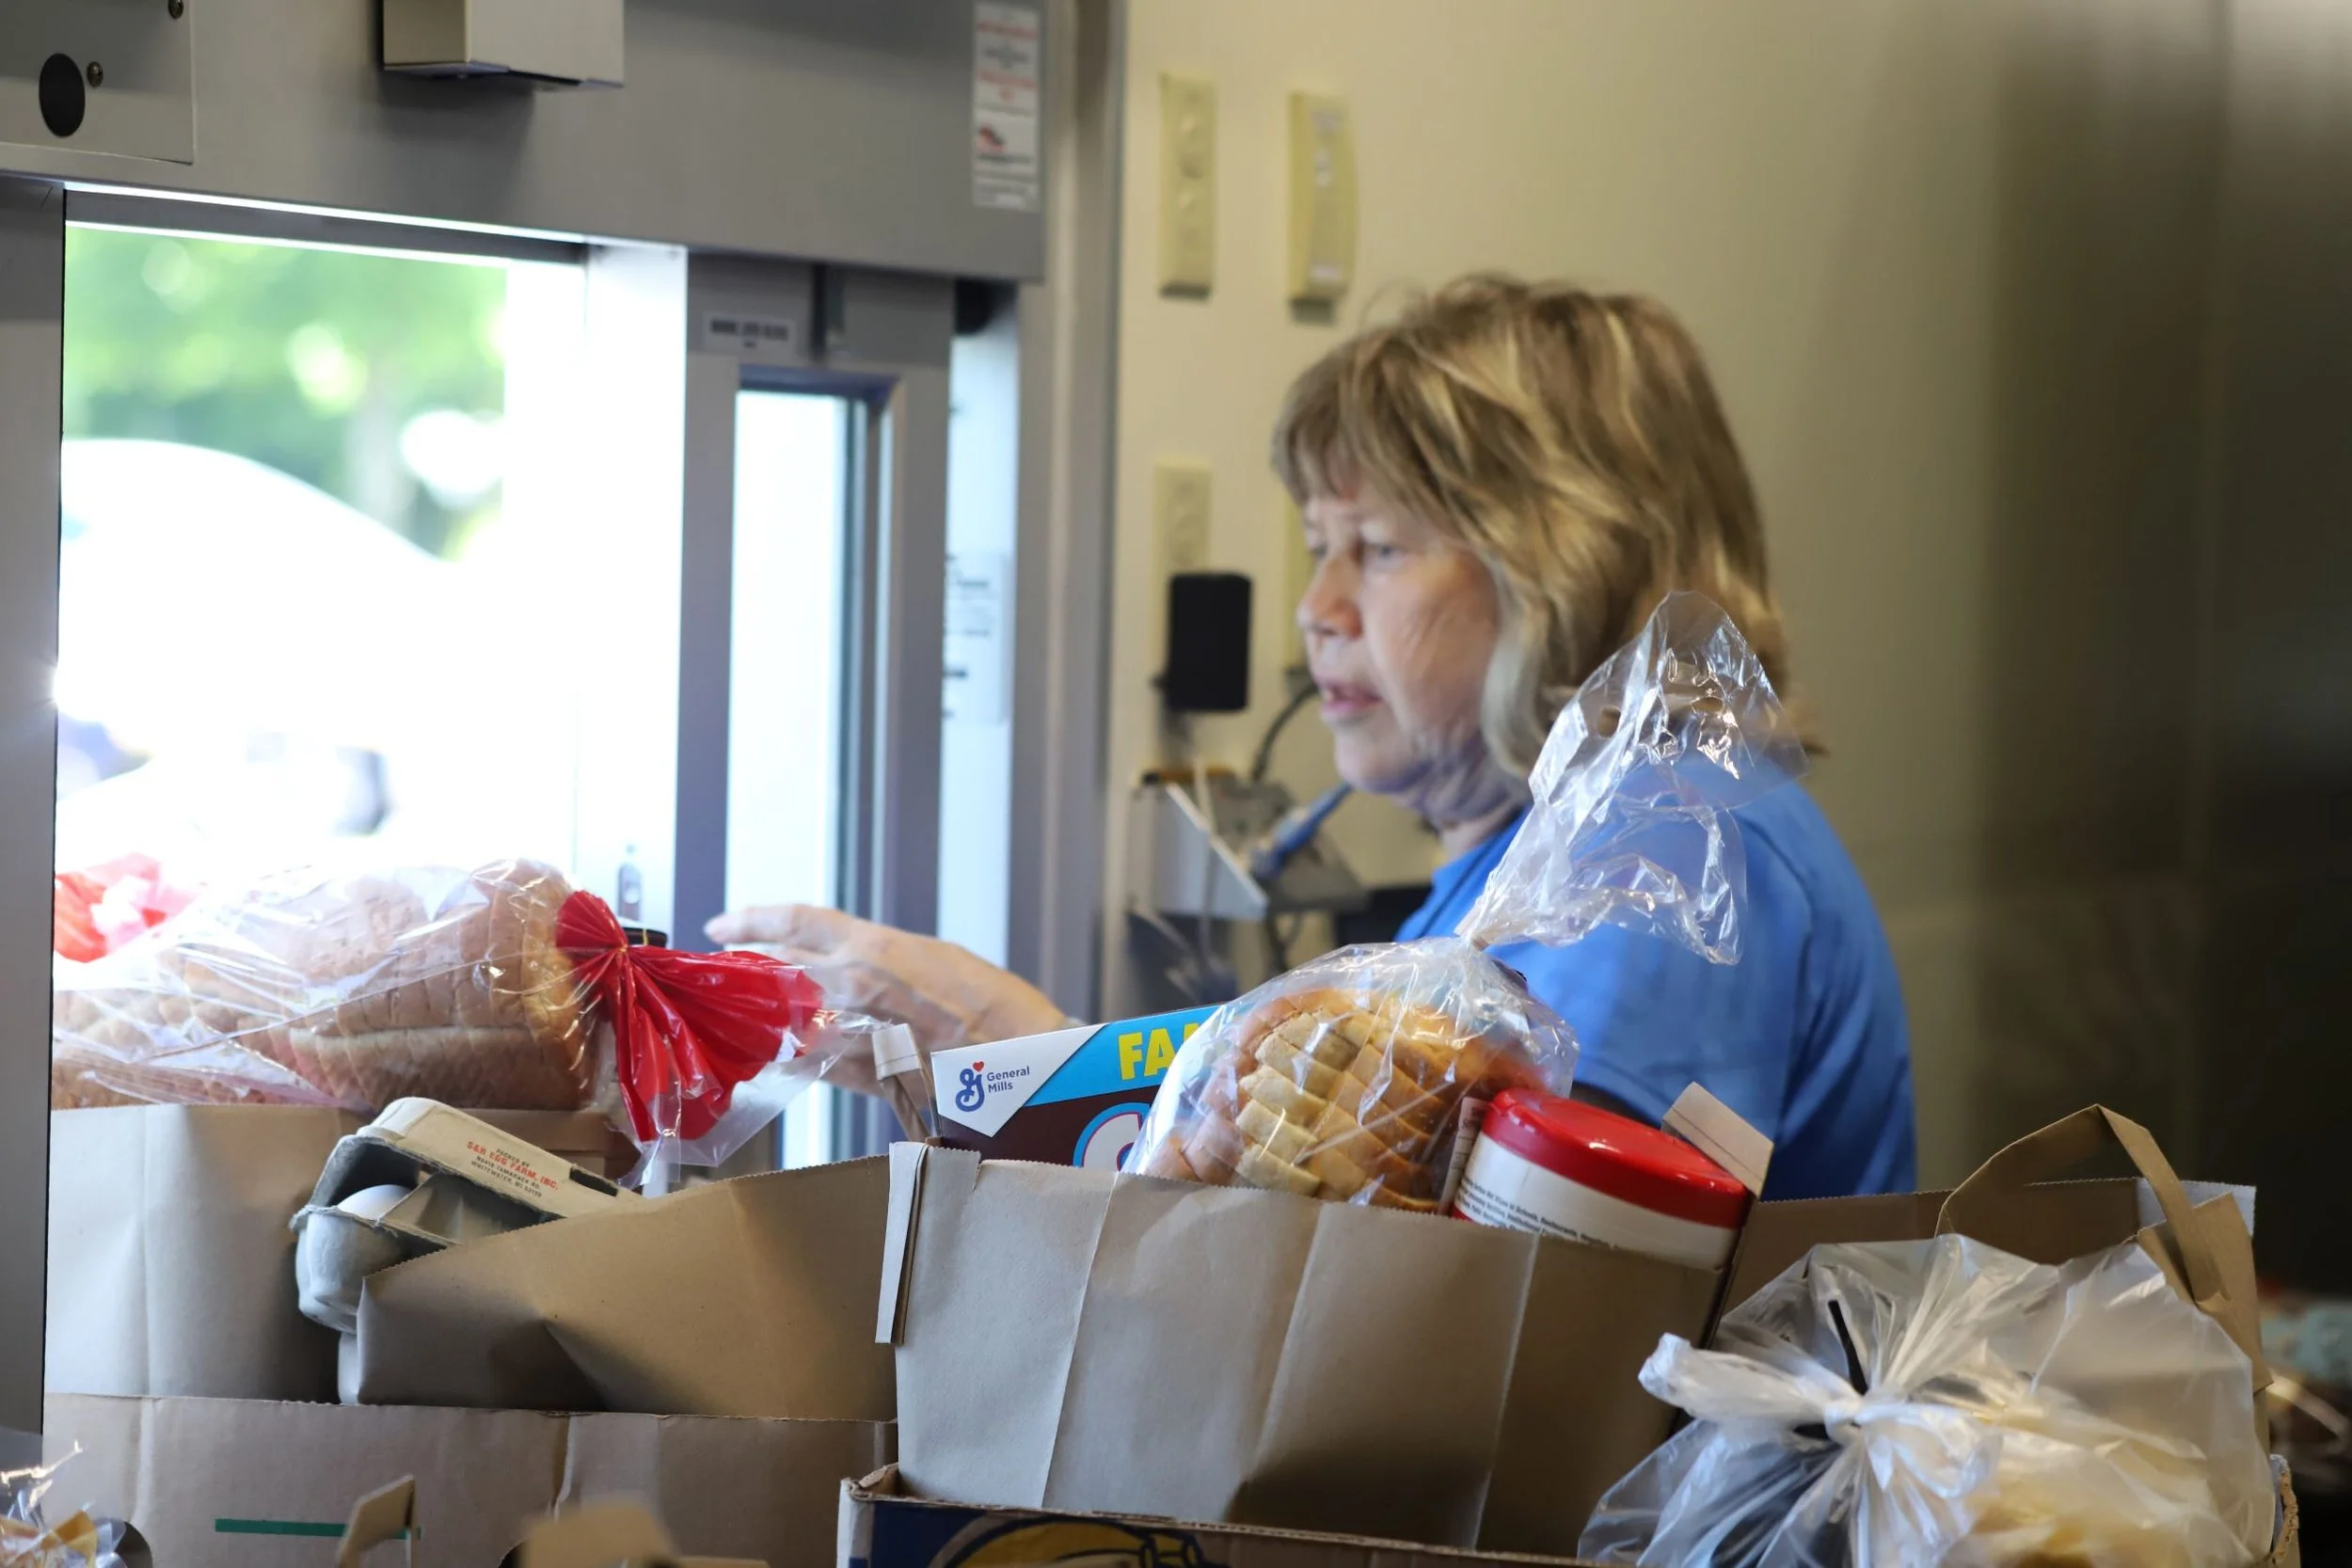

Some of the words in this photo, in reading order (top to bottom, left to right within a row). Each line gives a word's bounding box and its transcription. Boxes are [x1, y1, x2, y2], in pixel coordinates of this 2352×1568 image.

[1118, 1023, 1200, 1081] FA
[986, 1065, 1030, 1082] General
[988, 1081, 1013, 1094] Mills
[496, 1148, 520, 1164] PACKED
[467, 1140, 486, 1156] S&R
[489, 1150, 508, 1166] EGG
[539, 1175, 559, 1190] INC.
